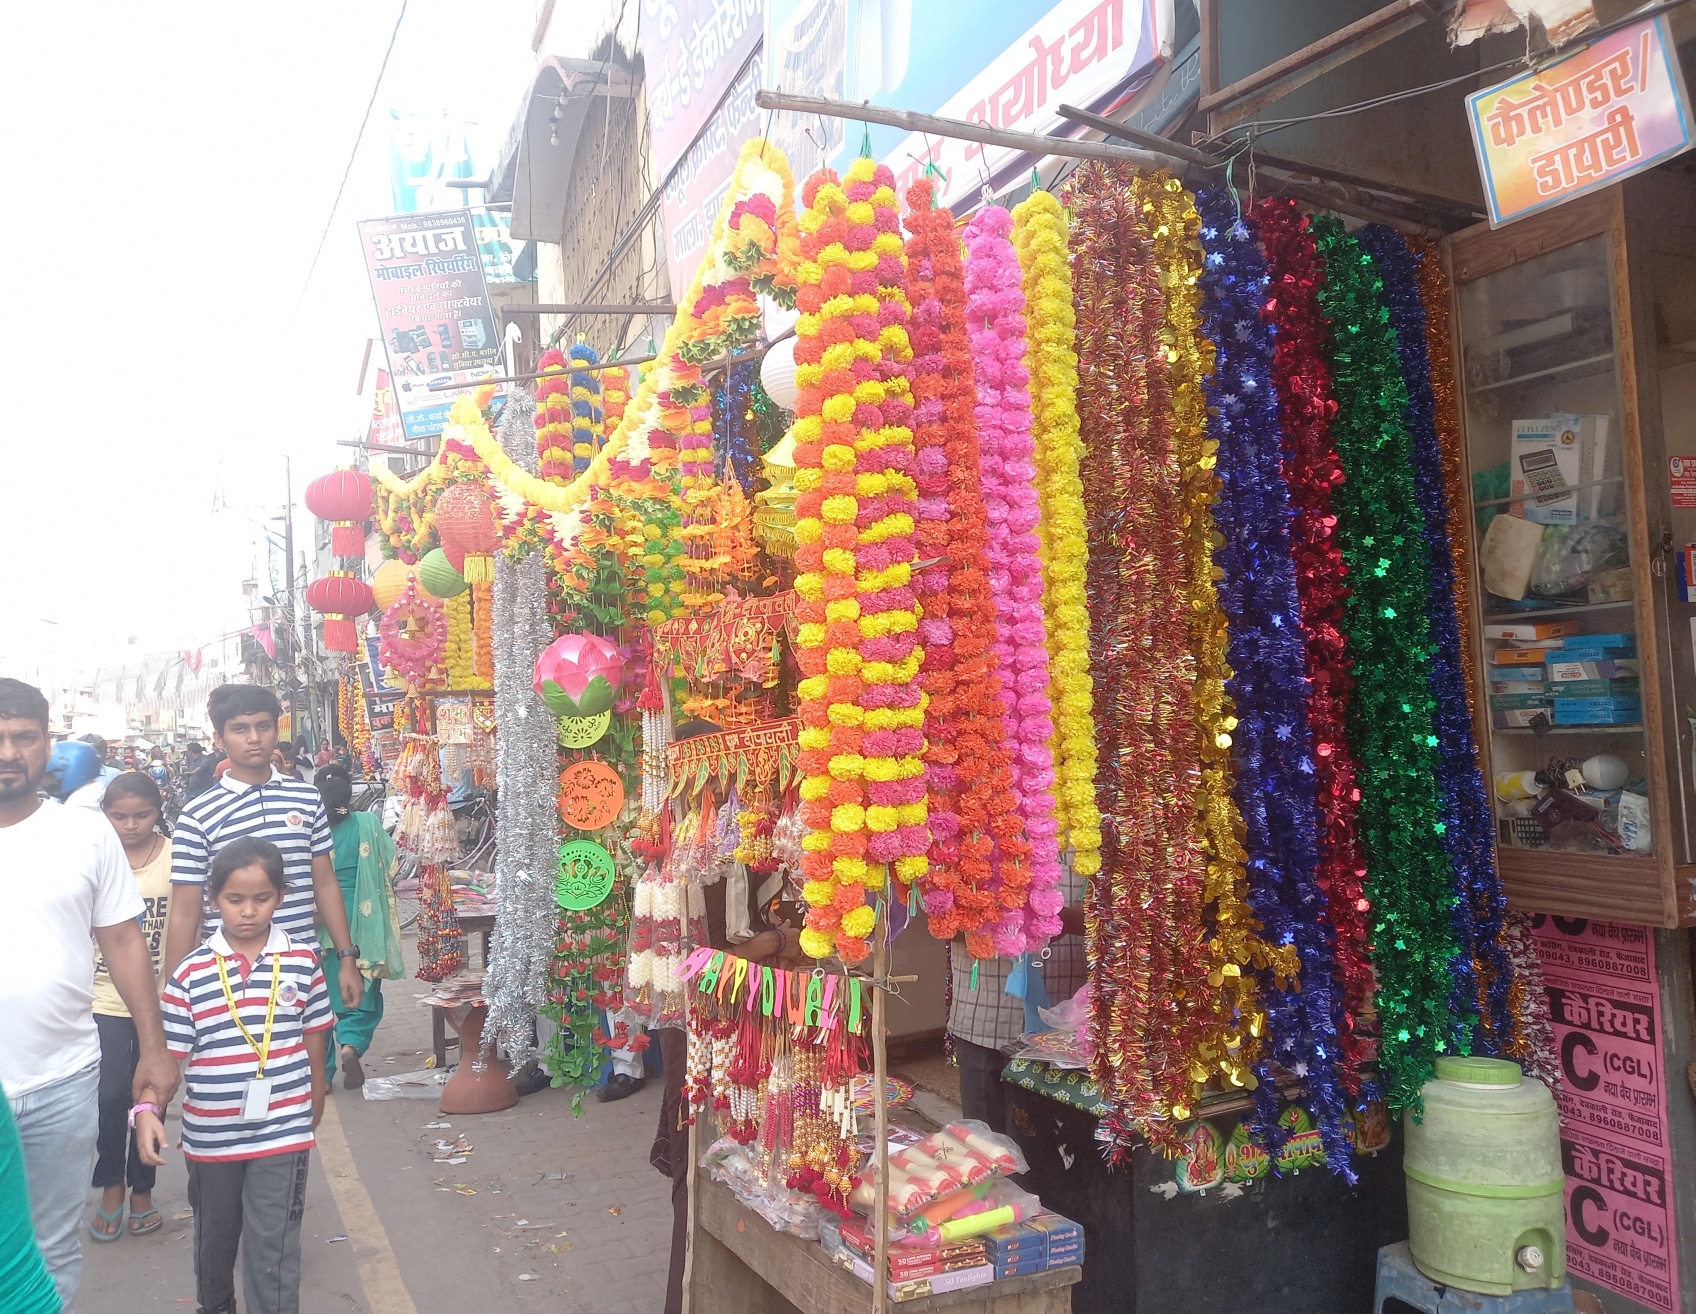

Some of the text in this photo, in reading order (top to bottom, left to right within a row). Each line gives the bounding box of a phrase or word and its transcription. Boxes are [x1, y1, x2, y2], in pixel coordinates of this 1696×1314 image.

[1529, 105, 1642, 196] डायरी
[423, 217, 466, 228] 9838960436
[370, 226, 468, 261] अयाज
[374, 263, 424, 280] मोबाइल
[425, 254, 478, 275] रिपेयरिंग
[740, 723, 792, 748] दीपावली
[143, 918, 165, 931] THAN
[1592, 923, 1606, 939] नया
[1578, 956, 1647, 976] 8960887008
[673, 947, 861, 1033] HAPPY DIWALI
[1561, 991, 1651, 1041] कैरियर
[1604, 1050, 1654, 1085] (CGL)
[1603, 1081, 1618, 1098] नया
[1589, 1112, 1659, 1141] 8960887008
[1571, 1144, 1661, 1204] कैरियर
[1613, 1208, 1664, 1249] (CGL)
[1613, 1238, 1628, 1257] नया
[898, 1257, 907, 1266] 50
[900, 1270, 909, 1279] 50
[944, 1271, 987, 1287] 50 Tealights
[1598, 1269, 1670, 1306] 8960887008
